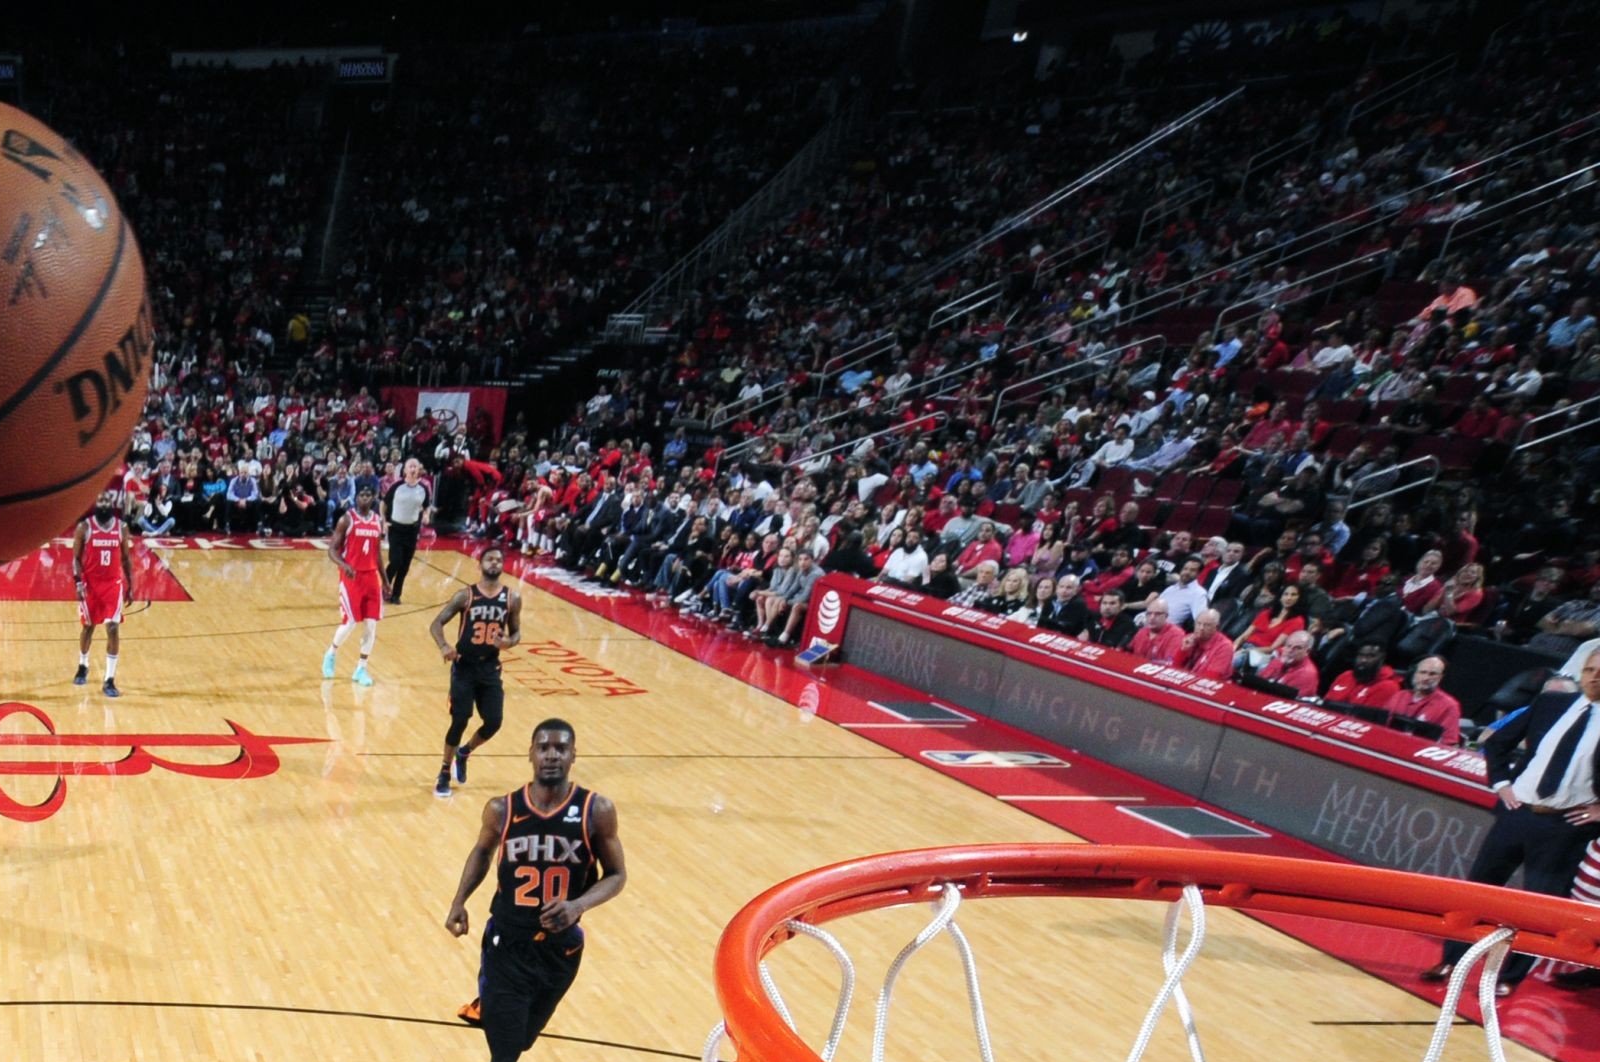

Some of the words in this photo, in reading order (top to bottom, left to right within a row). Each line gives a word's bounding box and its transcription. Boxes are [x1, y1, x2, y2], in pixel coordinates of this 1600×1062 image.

[100, 550, 111, 566] 13
[362, 539, 370, 556] 4
[470, 605, 507, 622] PHX
[471, 621, 501, 645] 30
[517, 641, 649, 697] TOYOTA
[1138, 727, 1279, 798] HEALTH
[1321, 779, 1481, 858] MEMORI
[505, 834, 583, 863] PHX
[1311, 808, 1469, 881] HERMAN
[514, 866, 570, 907] 20
